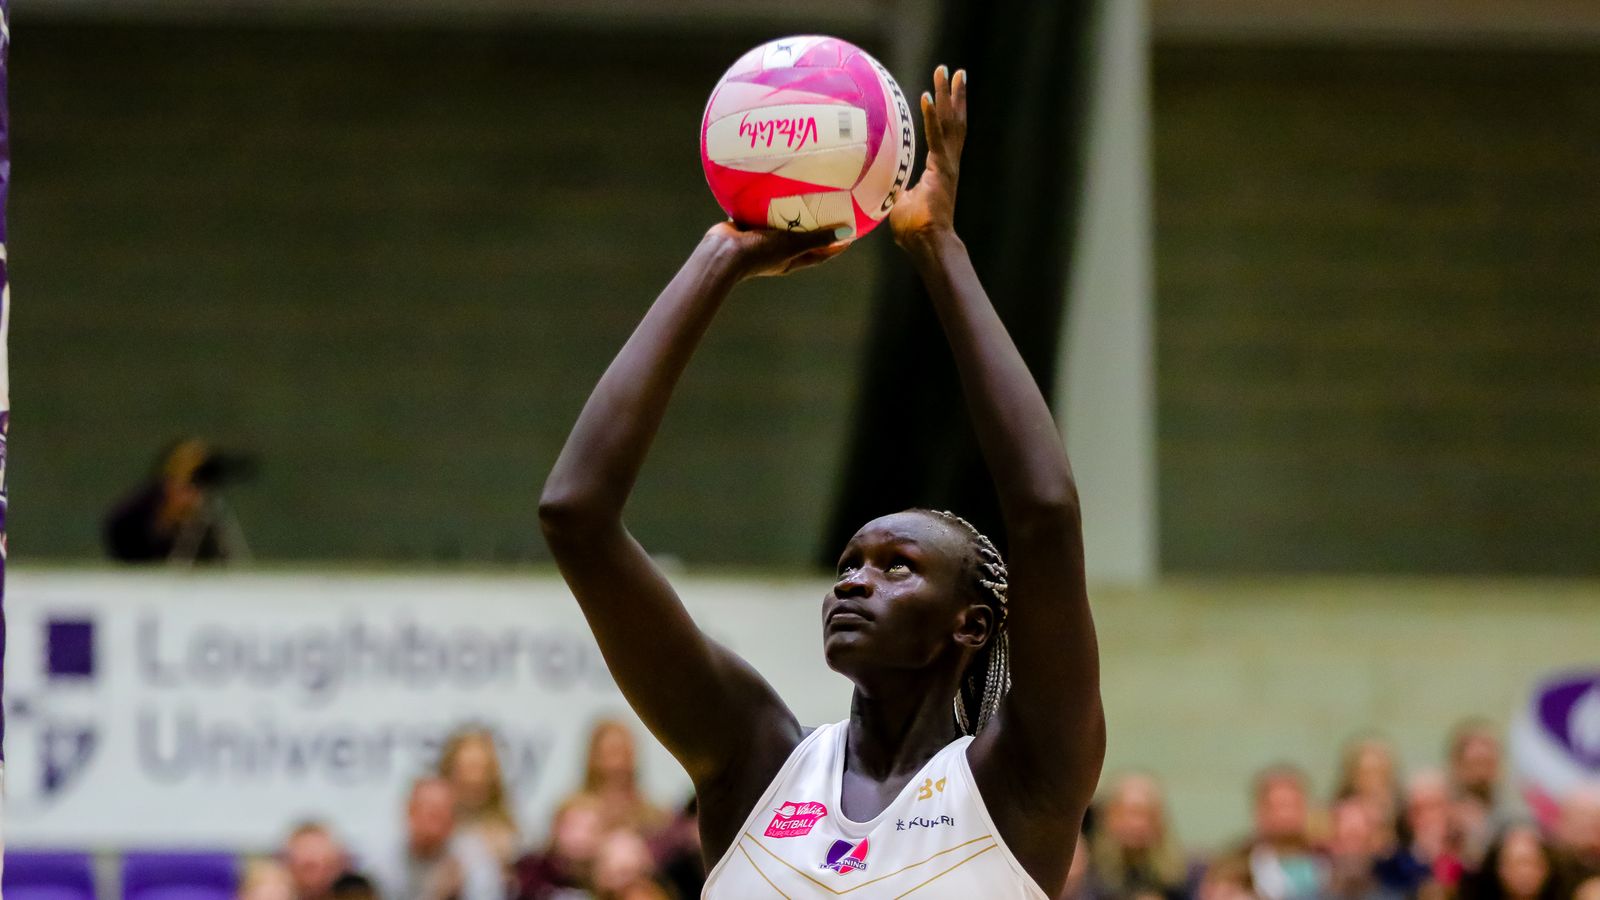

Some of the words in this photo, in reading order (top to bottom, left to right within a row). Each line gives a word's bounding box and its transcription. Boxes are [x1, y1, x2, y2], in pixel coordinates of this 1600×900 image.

[739, 112, 817, 152] Vitality
[137, 611, 608, 704] Loughboro
[771, 819, 815, 830] NETBALL
[908, 815, 955, 829] KUKRI
